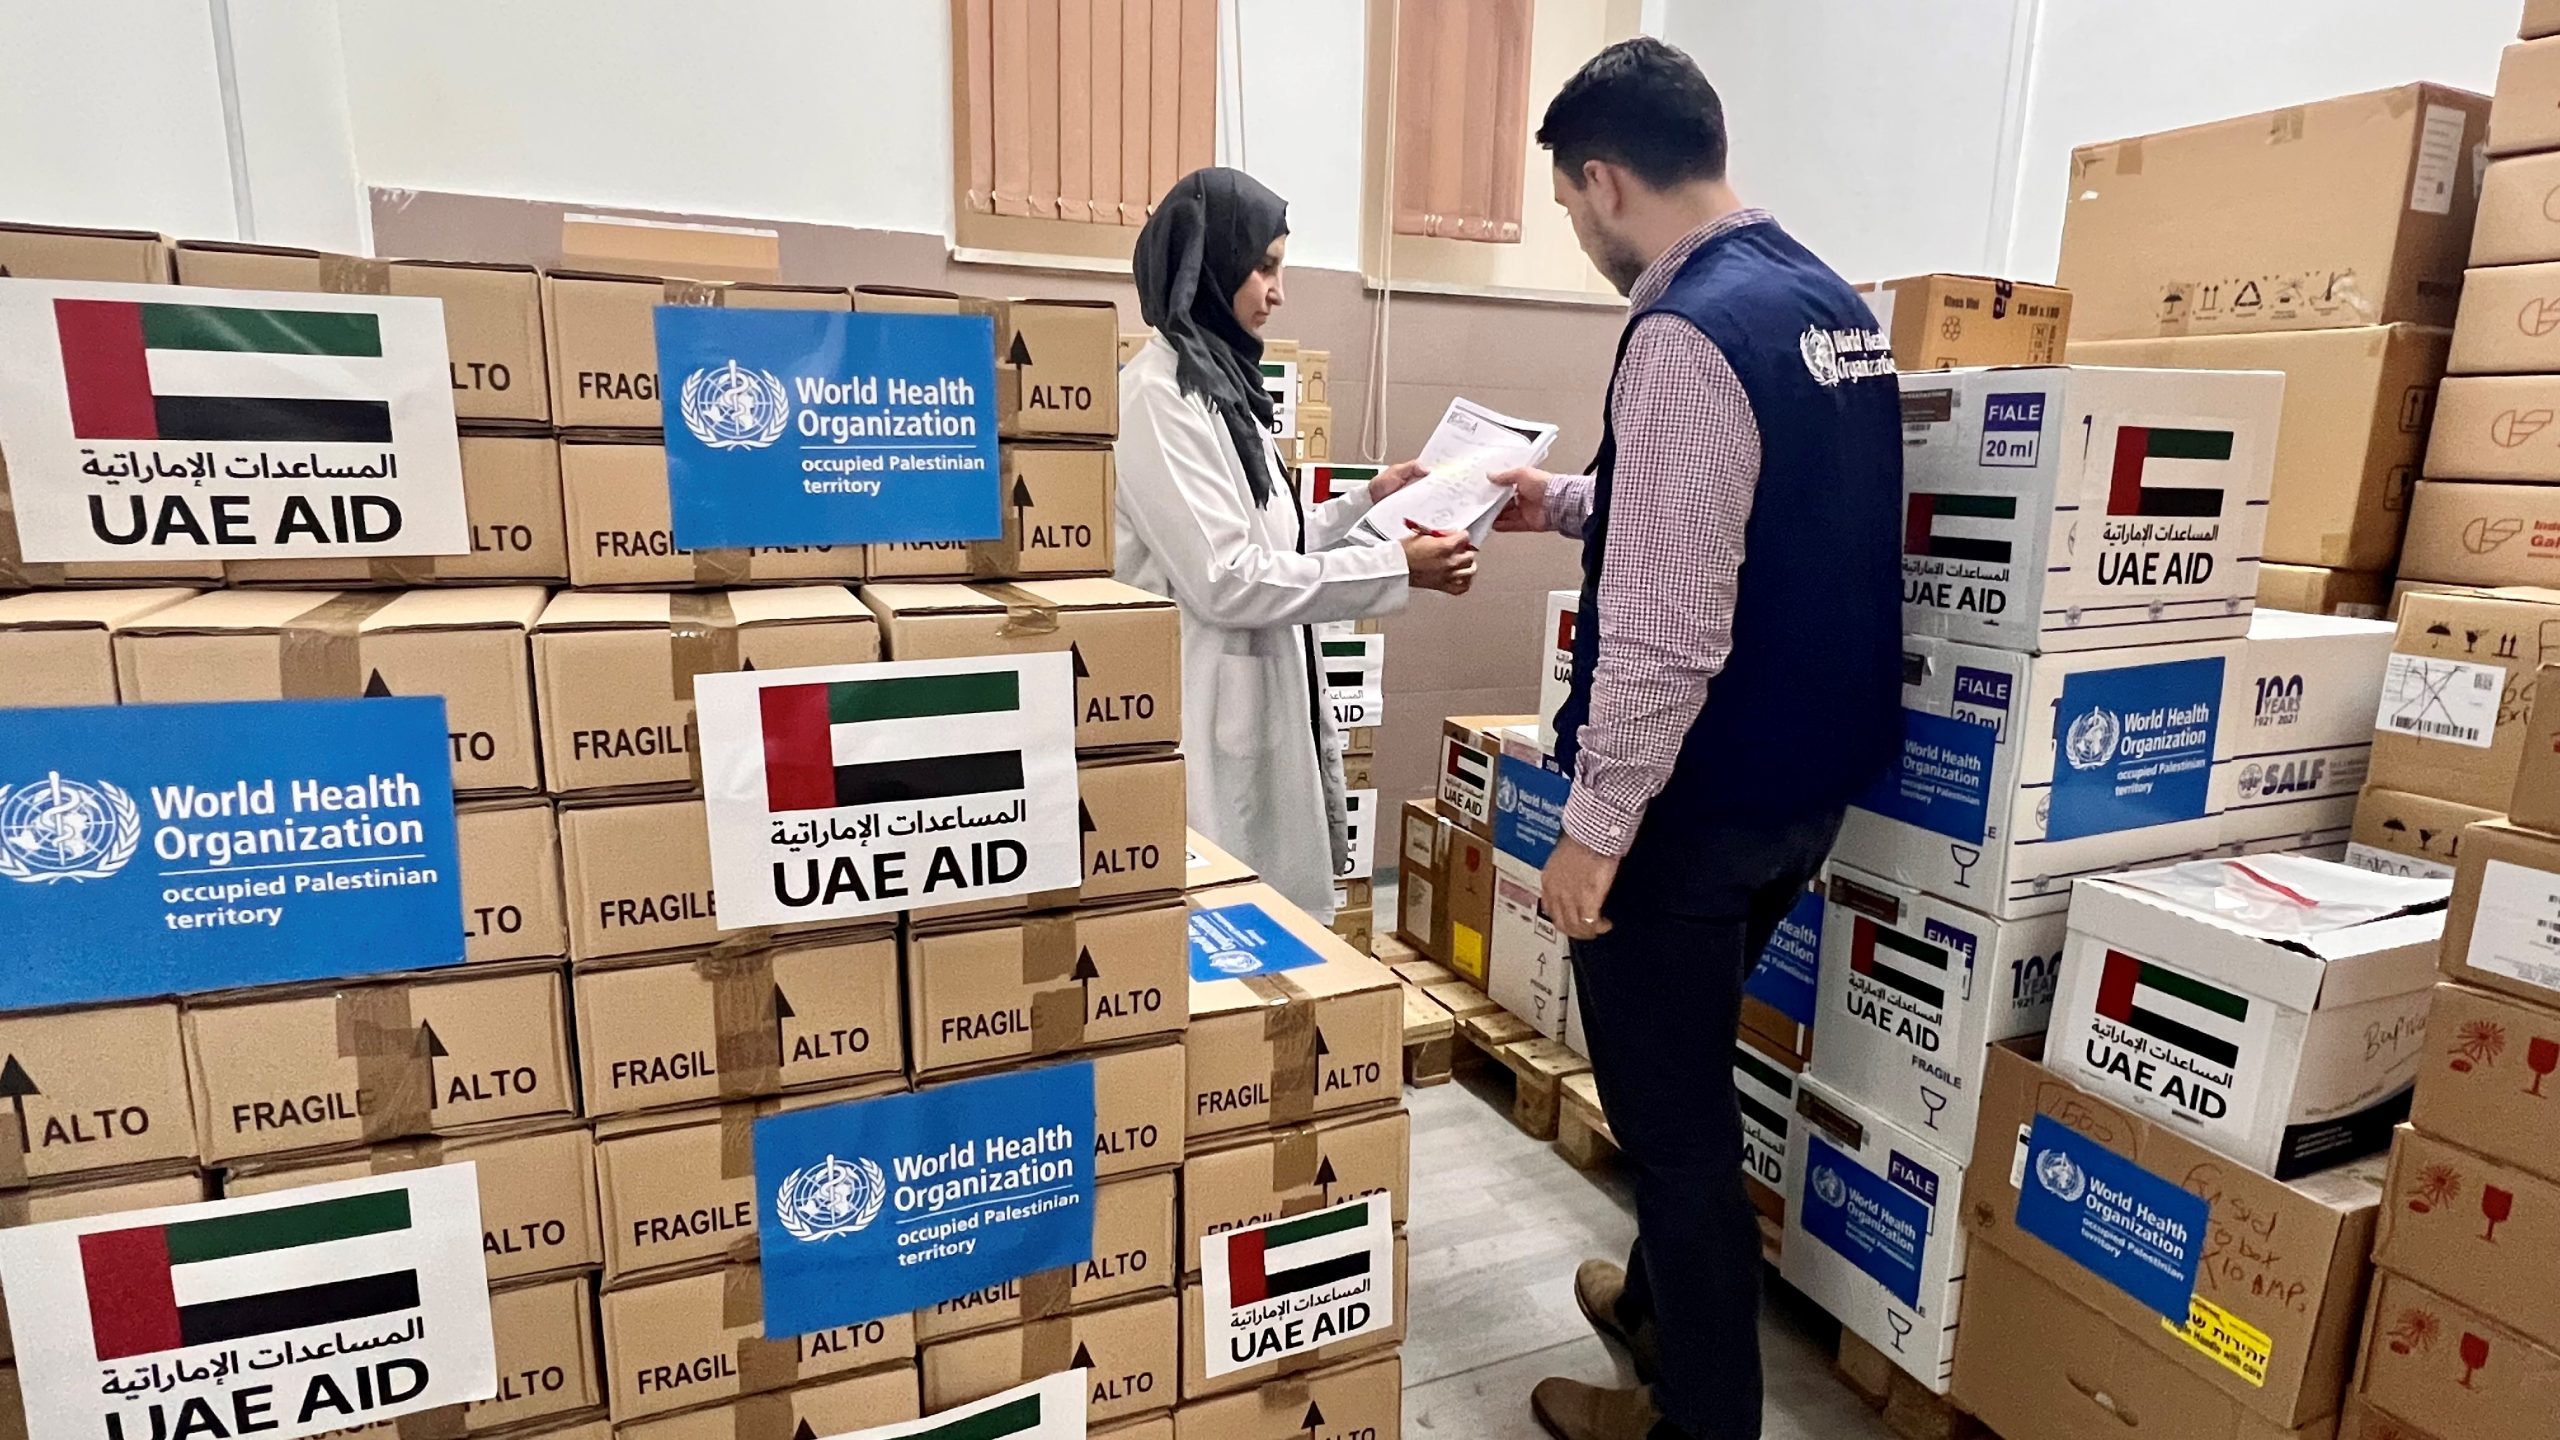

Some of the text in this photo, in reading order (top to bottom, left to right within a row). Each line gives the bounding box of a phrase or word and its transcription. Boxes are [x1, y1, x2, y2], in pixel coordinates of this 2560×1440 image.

[1833, 328, 1862, 353] World
[451, 362, 511, 391] LTO
[579, 372, 660, 400] FRAGI
[795, 376, 975, 406] World Health
[1030, 385, 1092, 410] ALTO
[1988, 404, 2040, 421] FIALE
[798, 409, 976, 444] Organization
[225, 452, 398, 480] المساعدات
[801, 454, 985, 474] occupied Palestinian
[1986, 440, 2033, 458] 20 ml
[803, 477, 881, 496] territory
[88, 495, 402, 546] UAE AID
[1032, 524, 1091, 549] ALTO
[2155, 524, 2219, 542] المساعدات
[470, 525, 532, 551] LTO
[2098, 552, 2214, 586] UAE AID
[1902, 580, 2007, 615] UAE AID
[1957, 677, 2008, 700] FIALE
[2255, 674, 2303, 716] 100
[2264, 696, 2301, 715] YEARS
[1086, 693, 1155, 723] ALTO
[2124, 702, 2209, 733] World Health
[2254, 714, 2298, 727] 1921 2021
[449, 732, 495, 762] TO
[1905, 739, 1981, 771] World Health
[2120, 727, 2206, 759] Organization
[1903, 755, 1979, 788] Organization
[2117, 758, 2206, 781] occupied Palestinian
[2262, 758, 2326, 796] SALF
[151, 774, 420, 819] World Health
[1444, 786, 1464, 808] UAE
[1465, 798, 1482, 817] AID
[2115, 781, 2153, 797] territory
[888, 799, 1027, 838] المساعدات
[154, 814, 423, 865] Organization
[774, 839, 1027, 907] UAE AID
[1093, 844, 1160, 875] ALTO
[162, 867, 438, 909] occupied Palestinian
[165, 906, 283, 930] territory
[465, 905, 522, 937] TO
[1096, 987, 1161, 1021] ALTO
[1847, 991, 1940, 1053] UAE AID
[793, 1027, 870, 1062] ALTO
[612, 1051, 715, 1089] FRAGIL
[1325, 1062, 1380, 1092] ALTO
[1911, 1055, 1962, 1090] FRAGILE
[2086, 1038, 2156, 1093] UAE
[2159, 1075, 2227, 1120] AID
[2149, 1045, 2234, 1090] المساعدات
[447, 1066, 538, 1104] ALTO
[1197, 1083, 1269, 1116] FRAGIL
[43, 1106, 149, 1147] ALTO
[1095, 1125, 1158, 1157] ALTO
[894, 1124, 1073, 1181] World Health
[1743, 1142, 1782, 1184] AID
[893, 1156, 1074, 1211] Organization
[1892, 1160, 1936, 1198] FIALE
[634, 1202, 752, 1246] FRAGILE
[898, 1193, 1080, 1245] occupied Palestinian
[1849, 1186, 1917, 1241] World Health
[2086, 1193, 2184, 1261] Organization
[2090, 1176, 2132, 1213] World
[2136, 1202, 2188, 1244] Health
[484, 1220, 565, 1255] ALTO
[1847, 1201, 1914, 1254] Organization
[2081, 1226, 2121, 1259] territory
[898, 1238, 977, 1267] territory
[1085, 1250, 1147, 1282] ALTO
[2083, 1216, 2184, 1283] occupied Palestinian
[1294, 1278, 1370, 1311] المساعدات
[248, 1316, 424, 1371] المساعدات
[811, 1320, 885, 1357] ALTO
[1231, 1301, 1371, 1363] UAE AID
[2213, 1327, 2267, 1366] זהירות
[495, 1366, 565, 1402] LTO
[638, 1354, 736, 1394] FRAGIL
[1092, 1372, 1153, 1403] ALTO
[105, 1358, 430, 1440] UAE AID
